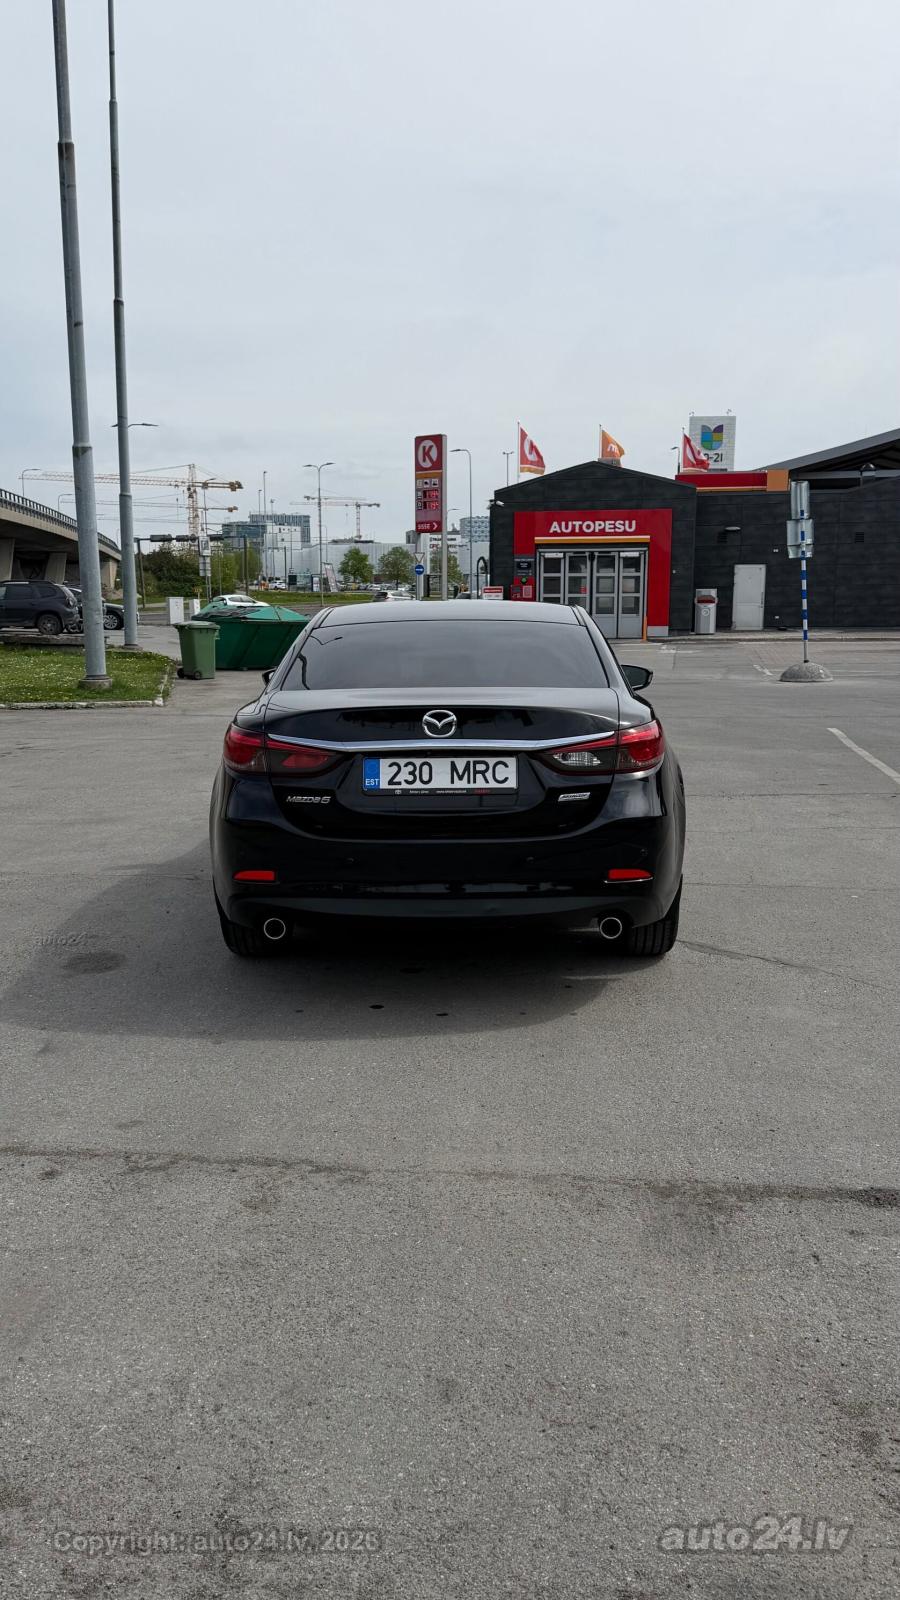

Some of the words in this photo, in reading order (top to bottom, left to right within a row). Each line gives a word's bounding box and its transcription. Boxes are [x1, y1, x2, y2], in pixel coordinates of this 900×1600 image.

[549, 519, 637, 534] AUTOPESU
[387, 761, 433, 786] 230
[450, 760, 510, 785] MRC
[365, 778, 380, 786] EST
